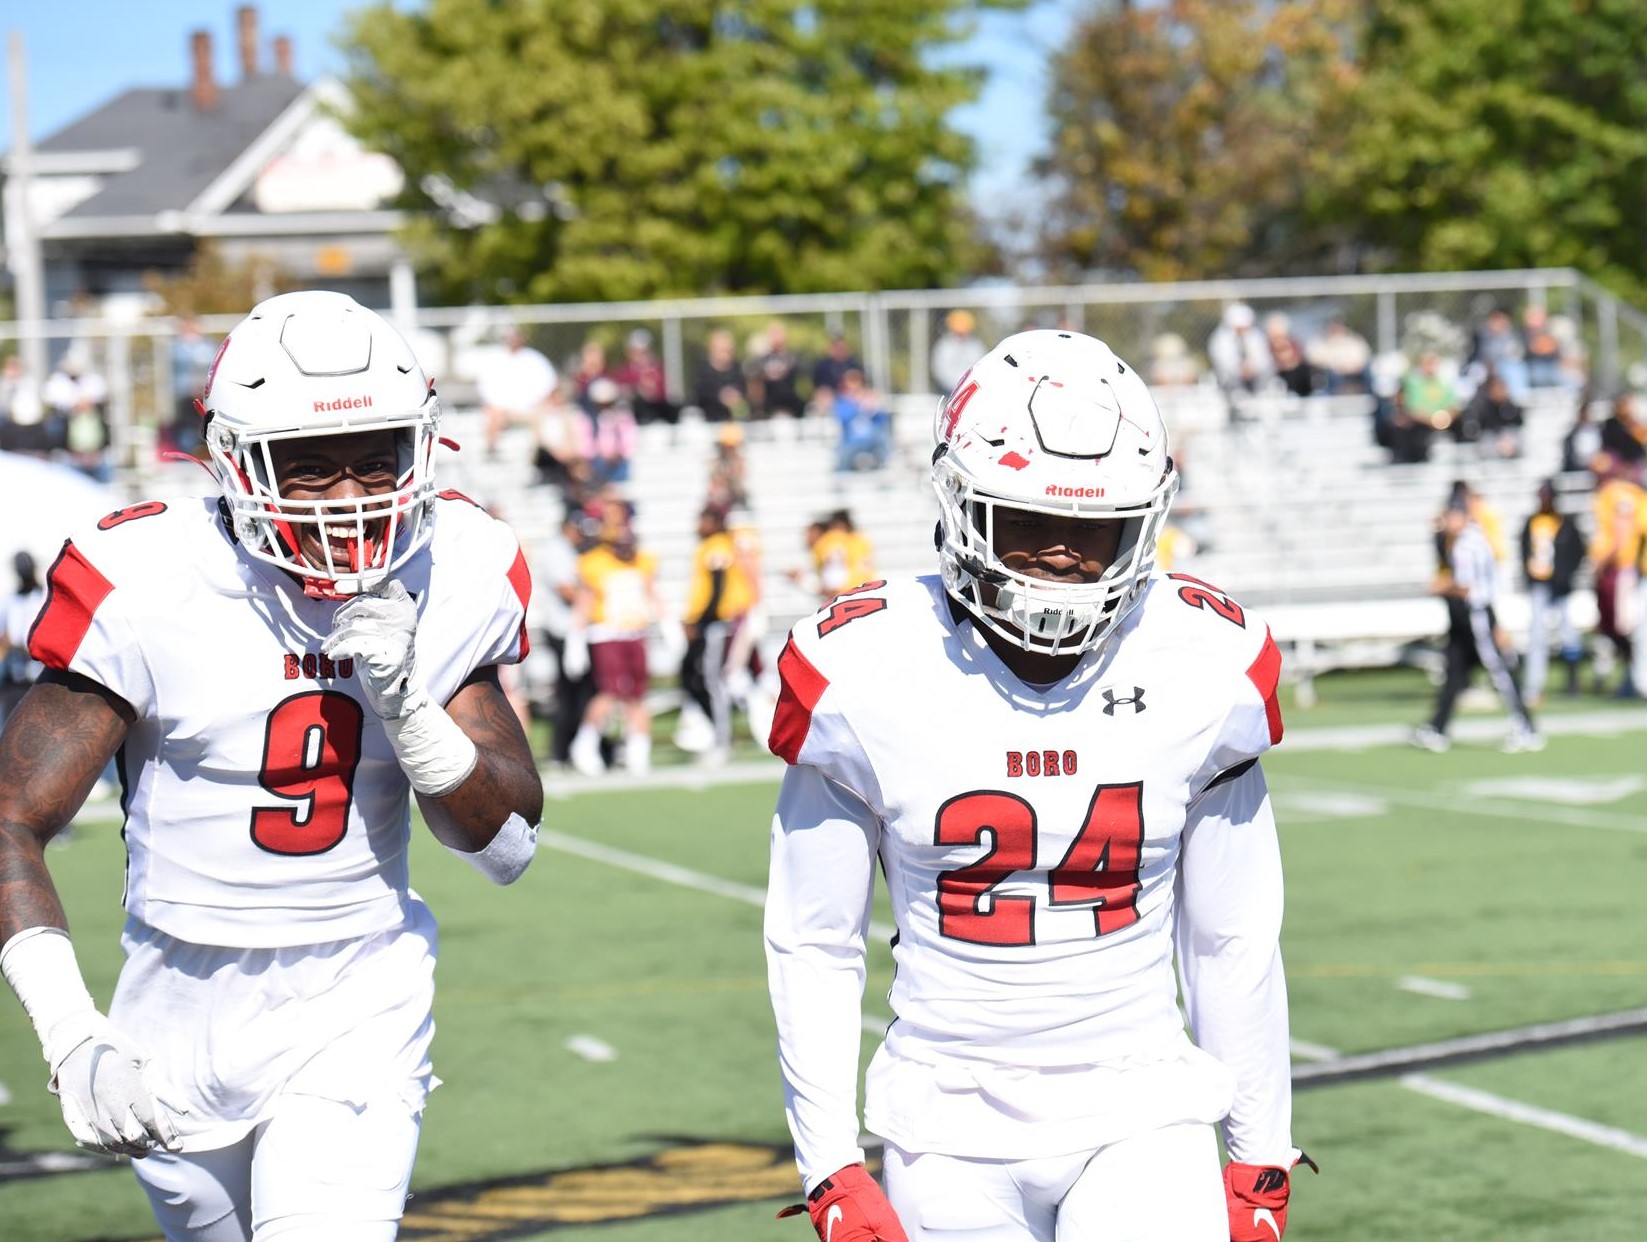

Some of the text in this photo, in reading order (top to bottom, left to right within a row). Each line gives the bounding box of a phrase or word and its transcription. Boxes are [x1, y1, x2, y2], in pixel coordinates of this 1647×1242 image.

[313, 395, 373, 413] Riddell
[1045, 484, 1106, 499] Riddell
[1043, 607, 1074, 616] Ridll
[283, 652, 354, 680] BORO
[250, 690, 364, 857] 9
[1006, 749, 1078, 778] BORO
[934, 780, 1145, 947] 24
